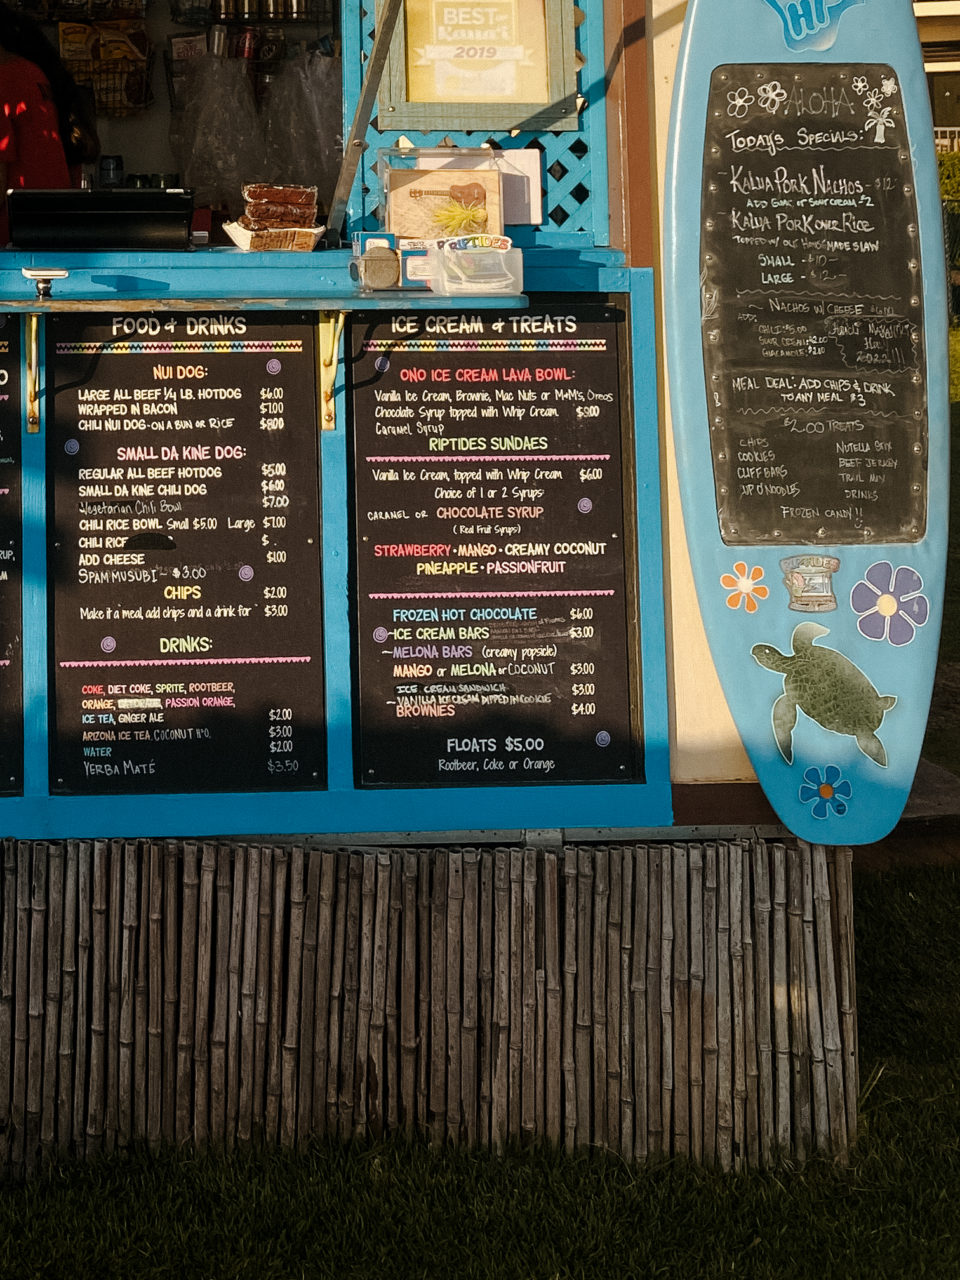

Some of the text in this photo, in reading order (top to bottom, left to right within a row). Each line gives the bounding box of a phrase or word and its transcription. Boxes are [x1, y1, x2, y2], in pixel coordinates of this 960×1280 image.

[444, 8, 499, 24] BEST
[453, 47, 497, 58] 2019
[785, 86, 854, 117] ALOHA
[774, 167, 812, 194] PORK
[812, 165, 864, 195] NACHOS
[762, 273, 794, 284] LARGE
[112, 317, 160, 336] FOOD
[186, 316, 247, 336] DRINKS
[392, 316, 418, 334] ICE
[425, 316, 484, 334] CREAM
[508, 316, 577, 334] TREATS
[153, 366, 208, 380] NUI DOG:
[400, 368, 576, 382] ONO ICE CREAM LAVA BOWL:
[732, 377, 759, 392] MEAL
[799, 378, 821, 390] ADD
[823, 379, 850, 392] CHIPS
[864, 382, 895, 396] DRINK
[817, 392, 843, 402] MEAL
[79, 404, 127, 416] WRAPPED
[131, 403, 140, 415] IN
[144, 402, 178, 415] BACON
[430, 436, 548, 452] RIPTIDES SUNDAES
[117, 445, 247, 461] SMALL DA KINE DOG:
[780, 506, 820, 518] FROZEN
[374, 542, 606, 557] STRAWBERRY MANGO CREAMY COCONUT
[79, 555, 100, 566] ADD
[103, 553, 145, 565] CHEESE
[164, 586, 201, 599] CHIPS
[394, 609, 438, 622] FROZEN
[442, 609, 466, 620] HOT
[470, 608, 538, 620] CHOCOLATE
[160, 637, 213, 653] DRINKS:
[447, 736, 544, 752] FLOATS $5.00
